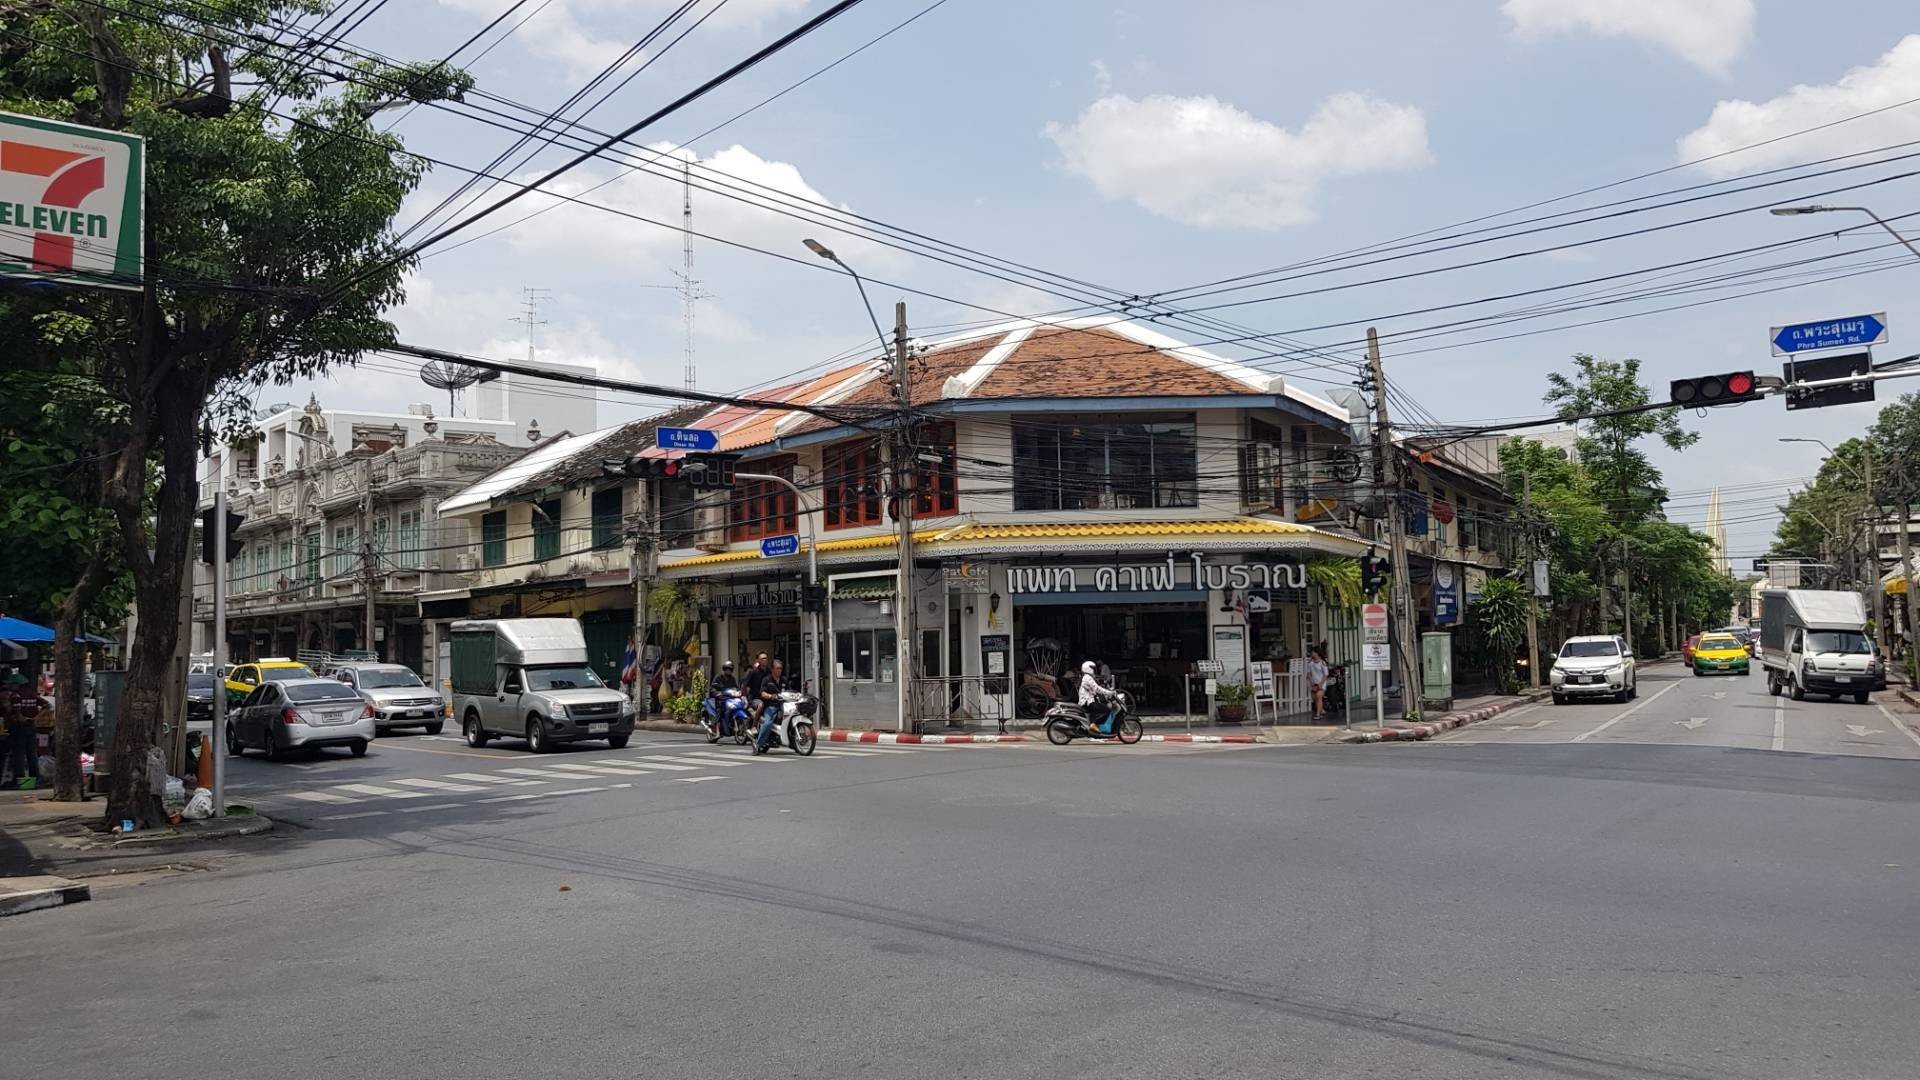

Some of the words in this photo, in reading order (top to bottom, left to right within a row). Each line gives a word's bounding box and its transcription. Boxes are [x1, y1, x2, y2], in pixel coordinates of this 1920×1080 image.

[1797, 341, 1815, 350] Phra
[1006, 565, 1076, 594] แพท
[1095, 551, 1176, 593] คาเฟ่
[1192, 552, 1306, 590] โบราณ
[216, 668, 224, 679] 6
